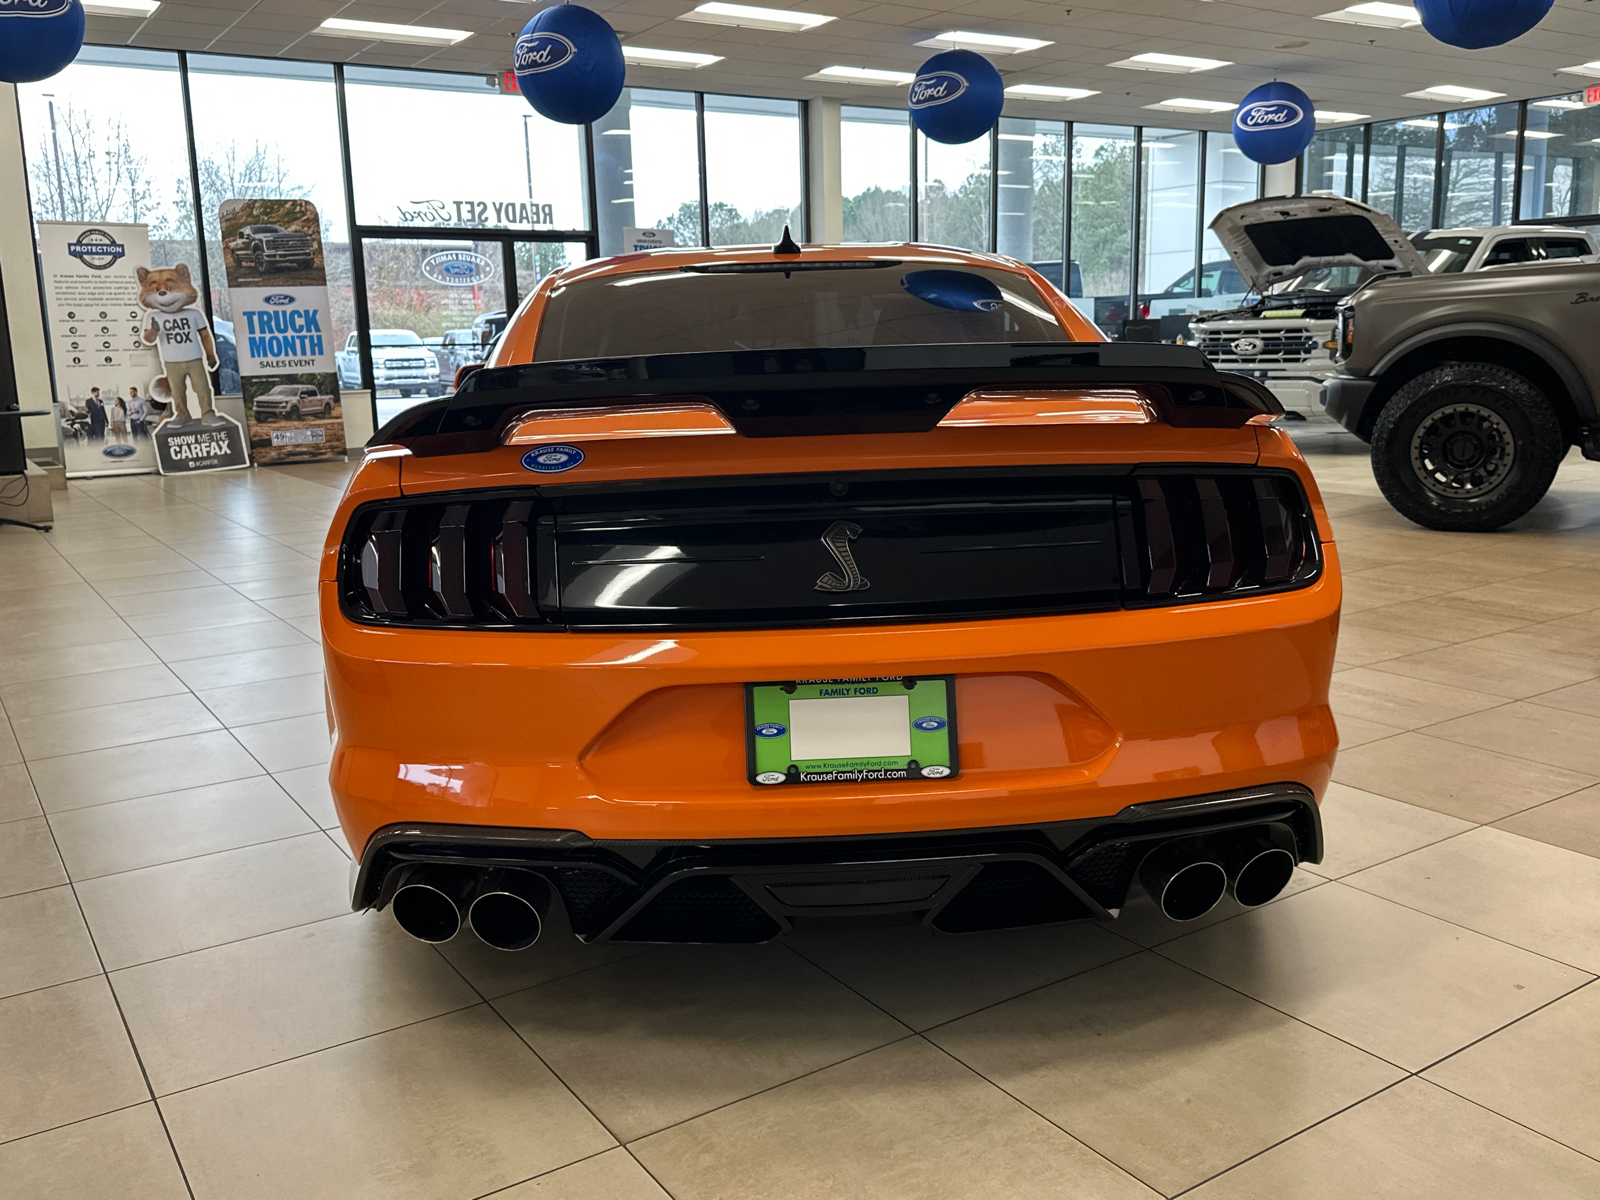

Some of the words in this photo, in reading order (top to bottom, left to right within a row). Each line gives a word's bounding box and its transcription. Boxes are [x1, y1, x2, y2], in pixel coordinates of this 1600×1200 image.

[515, 40, 552, 68] Ford
[504, 72, 521, 92] EX
[912, 78, 948, 102] Ford
[1247, 106, 1287, 125] Ford
[70, 245, 122, 253] PROTECTION
[270, 295, 290, 304] Ford
[163, 318, 190, 331] CAR
[242, 309, 321, 335] TRUCK
[166, 331, 193, 344] FOX
[248, 335, 324, 358] MONTH
[260, 360, 287, 368] SALES
[289, 359, 316, 367] EVENT
[168, 435, 195, 446] SHOW
[198, 433, 211, 443] ME
[212, 431, 228, 441] THE
[170, 440, 231, 460] CARFAX
[531, 448, 554, 457] KRAUSE
[195, 459, 218, 467] #CARFOX
[820, 687, 851, 696] FAMILY
[853, 687, 878, 695] FORD
[804, 761, 899, 770] www.KrauseFamilyFord.com
[927, 768, 945, 776] Ford
[762, 774, 779, 782] Ford
[800, 768, 907, 782] KrauseFamilyFord.com
